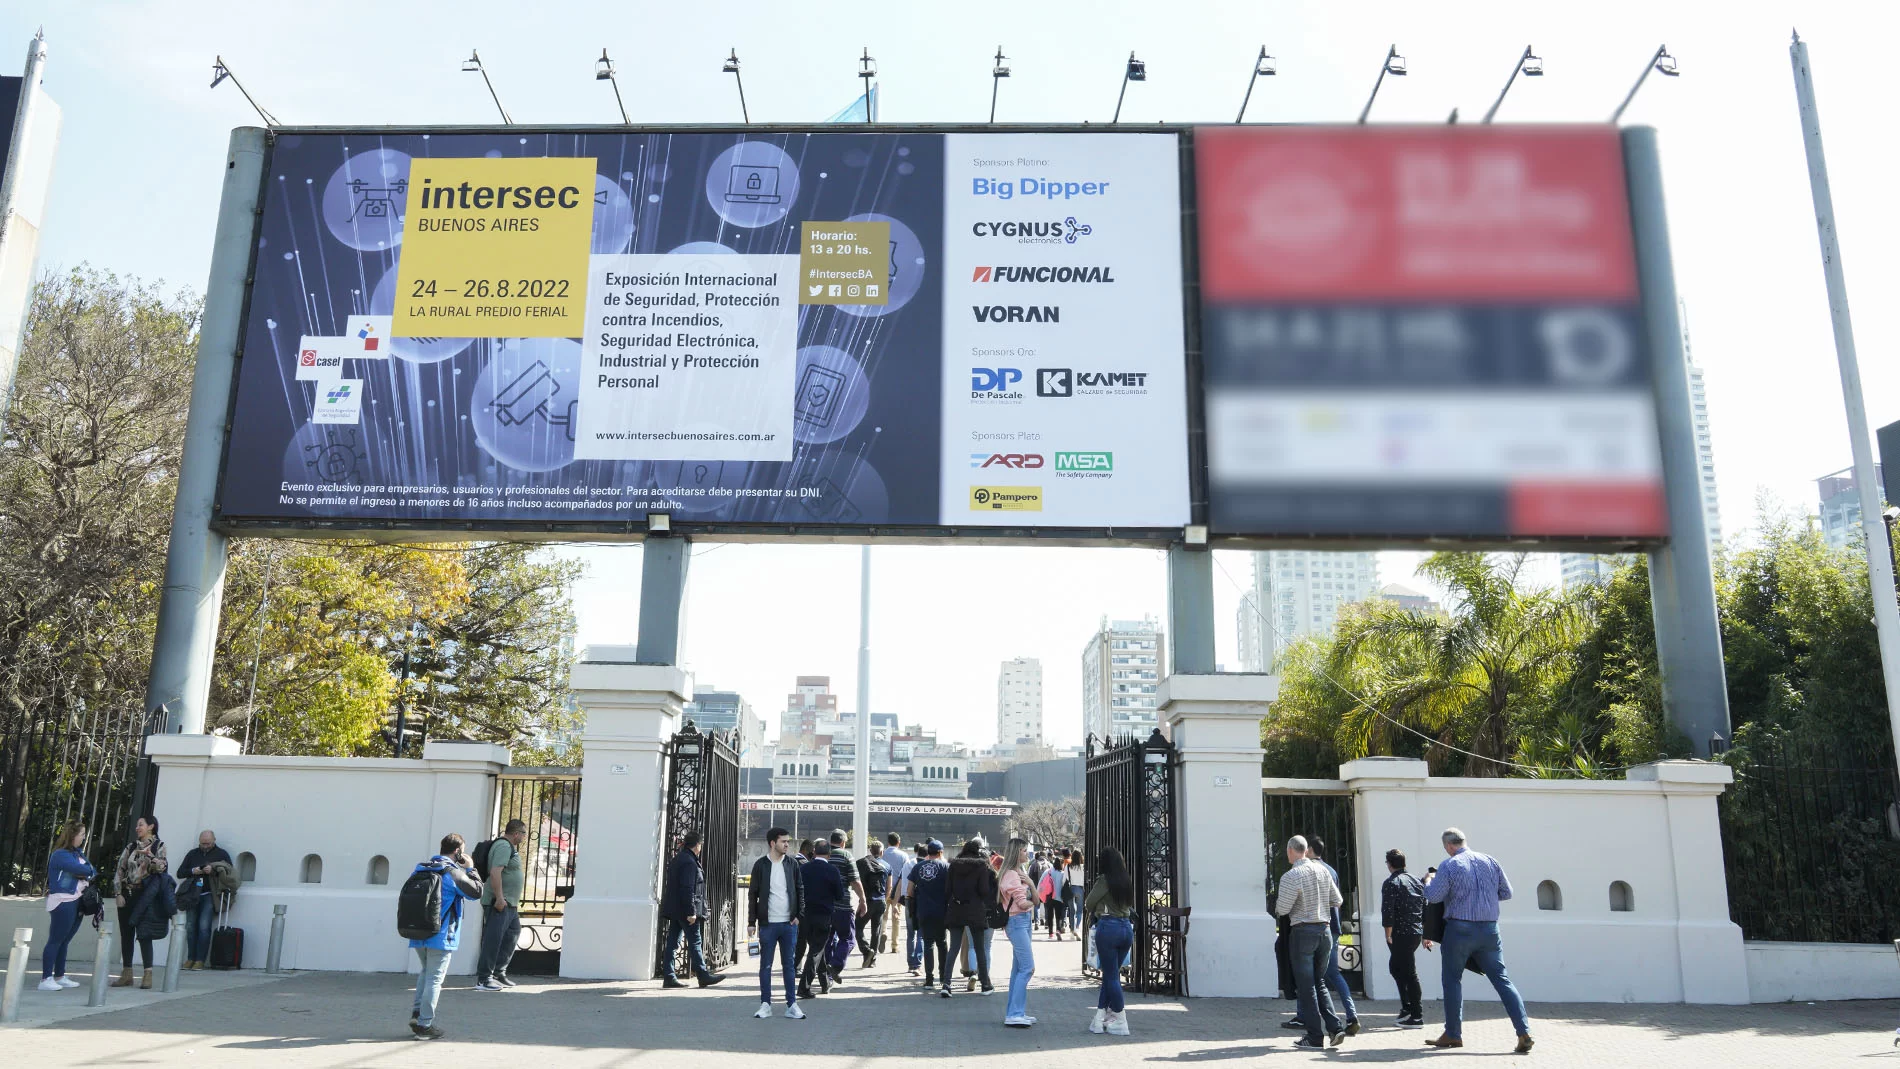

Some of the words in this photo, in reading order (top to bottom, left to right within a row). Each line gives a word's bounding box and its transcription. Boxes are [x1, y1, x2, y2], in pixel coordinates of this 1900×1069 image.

[973, 158, 1014, 168] Sponsors
[420, 178, 580, 209] intersec
[972, 178, 1014, 200] Big
[1020, 178, 1110, 200] Dipper
[418, 218, 486, 232] BUENOS
[490, 218, 540, 232] AIRES
[972, 222, 1063, 237] CYGNUS
[811, 230, 857, 240] Horario:
[1018, 236, 1062, 244] electronics
[810, 244, 823, 254] 13
[826, 246, 833, 254] a
[836, 244, 852, 254] 20
[855, 244, 872, 254] hs.
[809, 268, 873, 279] #IntersecBA
[994, 266, 1114, 282] FUNCIONAL
[605, 272, 680, 290] Exposición
[684, 273, 778, 287] Internacional
[412, 279, 438, 298] 24
[464, 279, 570, 298] 26.8.2022
[603, 293, 620, 306] de
[624, 293, 700, 310] Seguridad,
[704, 292, 780, 307] Protección
[410, 306, 426, 318] LA
[429, 306, 472, 318] RURAL
[475, 306, 521, 318] PREDIO
[525, 306, 568, 318] FERIAL
[972, 306, 1060, 322] VORAN
[602, 315, 646, 327] contra
[651, 313, 724, 329] Incendios,
[600, 334, 672, 352] Seguridad
[676, 333, 760, 350] Electrónica,
[972, 347, 1015, 358] Sponsors
[316, 356, 340, 366] casel
[599, 354, 667, 368] Industrial
[671, 358, 679, 372] y
[684, 354, 760, 368] Protección
[598, 374, 660, 388] Personal
[972, 368, 1022, 392] DP
[1076, 372, 1148, 386] KAMET
[596, 430, 776, 442] www.intersecbuenosaires.com.ar
[972, 431, 1015, 442] Sponsors
[1058, 454, 1110, 468] MSA
[281, 482, 314, 492] Evento
[316, 483, 360, 492] exclusivo
[363, 485, 385, 495] para
[388, 484, 450, 496] empresarios,
[452, 485, 494, 494] usuarios
[496, 486, 502, 496] y
[504, 486, 570, 497] profesionales
[573, 486, 588, 495] del
[590, 486, 624, 496] sector.
[626, 486, 648, 496] Para
[650, 486, 706, 496] acreditarse
[708, 487, 733, 496] debe
[736, 488, 782, 499] presentar
[785, 489, 797, 497] su
[800, 488, 822, 498] DNI.
[992, 492, 1038, 502] Pampero
[280, 496, 293, 504] No
[310, 496, 347, 507] permite
[350, 496, 358, 505] el
[361, 496, 396, 508] ingreso
[408, 498, 450, 506] menores
[452, 498, 465, 506] de
[468, 498, 478, 507] 16
[481, 498, 504, 508] años
[508, 498, 542, 508] incluso
[544, 499, 613, 511] acompañados
[616, 501, 632, 512] por
[635, 501, 648, 509] un
[650, 500, 684, 510] adulto.
